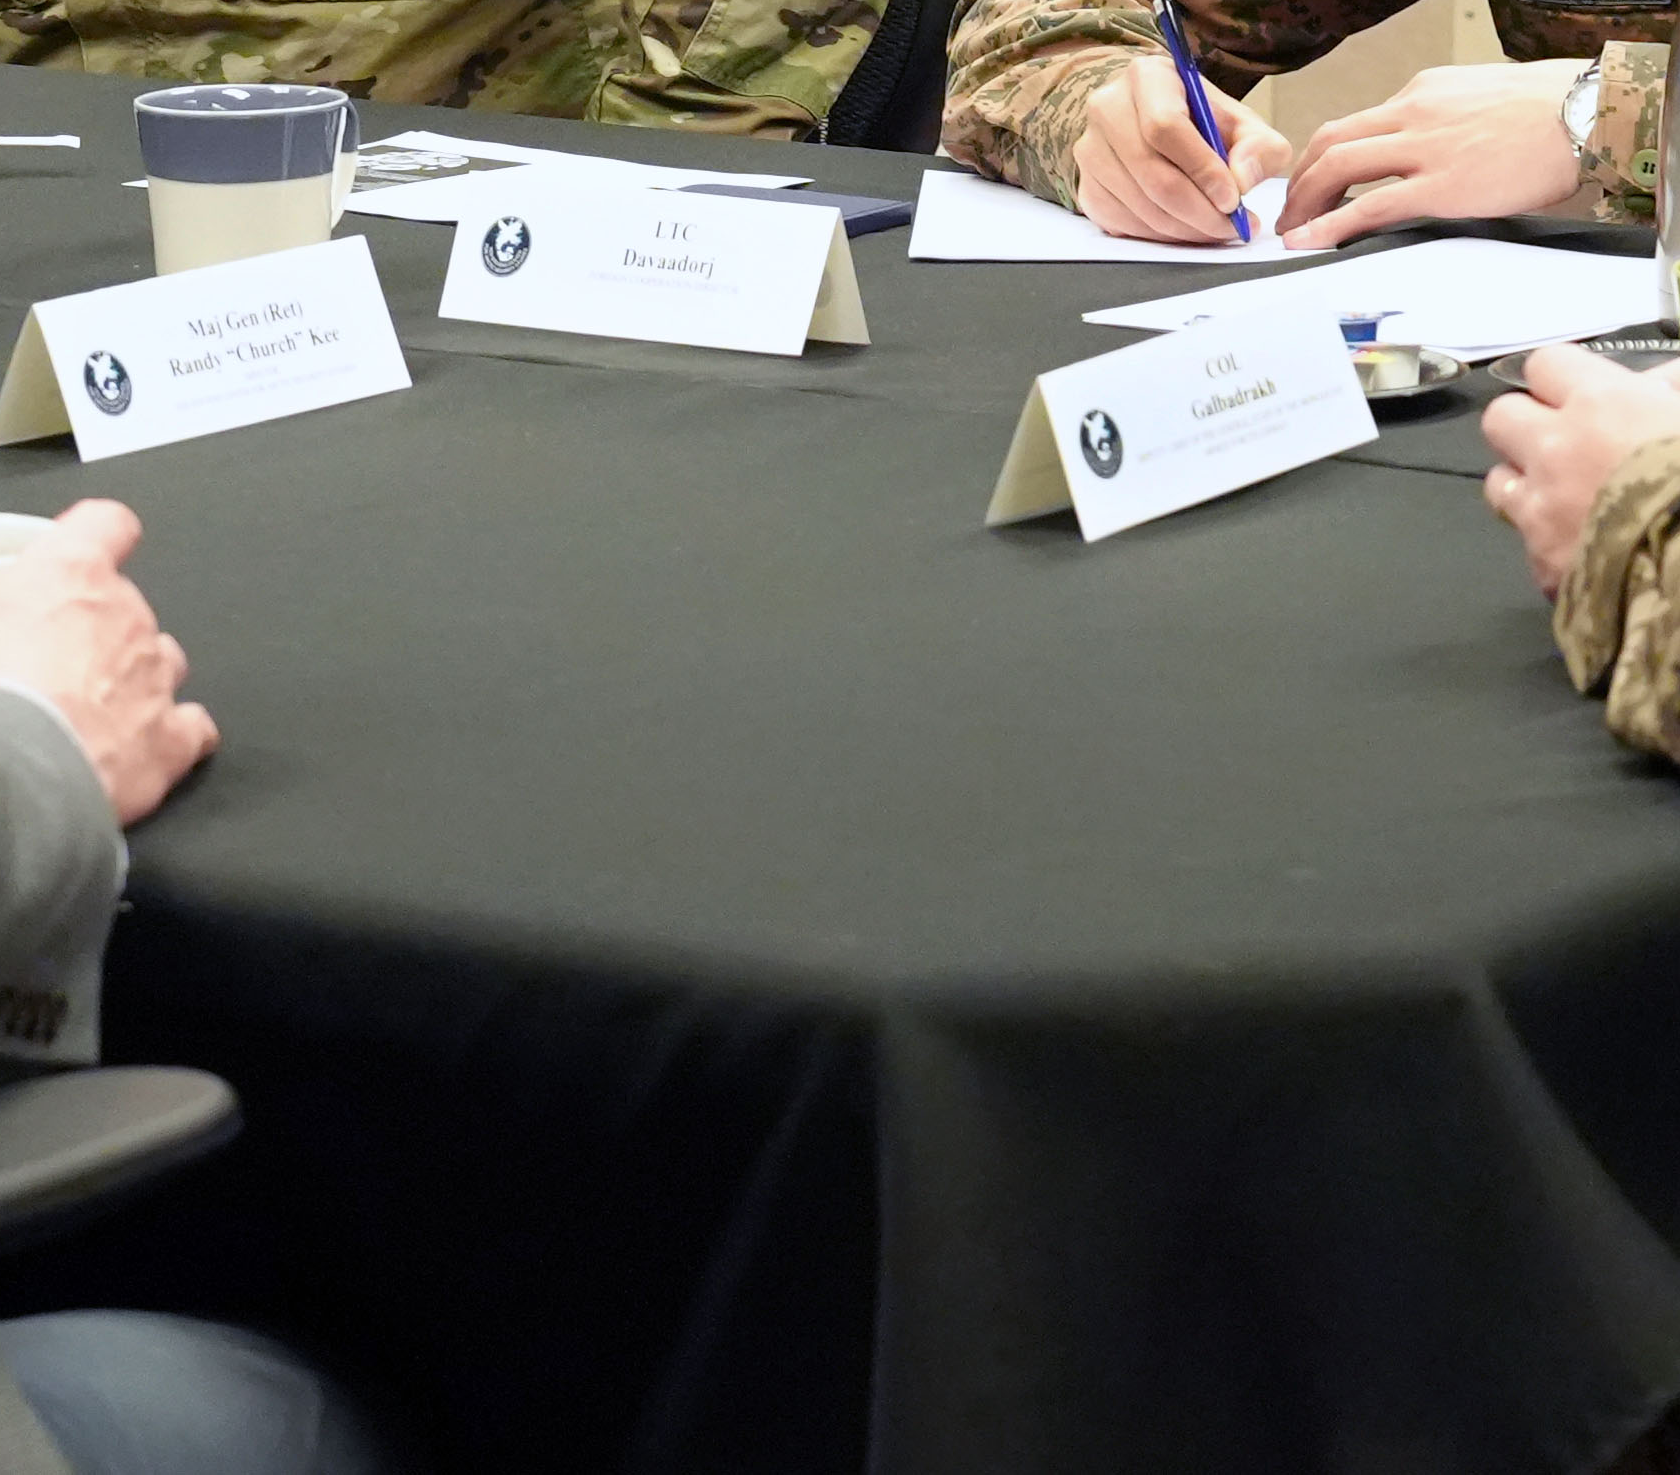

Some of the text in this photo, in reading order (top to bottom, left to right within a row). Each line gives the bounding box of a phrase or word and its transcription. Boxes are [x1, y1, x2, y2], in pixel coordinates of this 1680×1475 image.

[654, 220, 698, 242] LTC
[622, 247, 717, 279] Davaadorj
[188, 299, 305, 339] Maj Gen (Ret)
[169, 351, 224, 376] Randy
[307, 326, 341, 347] Kee
[1205, 351, 1243, 380] COL
[1190, 376, 1278, 421] Galbadrakh
